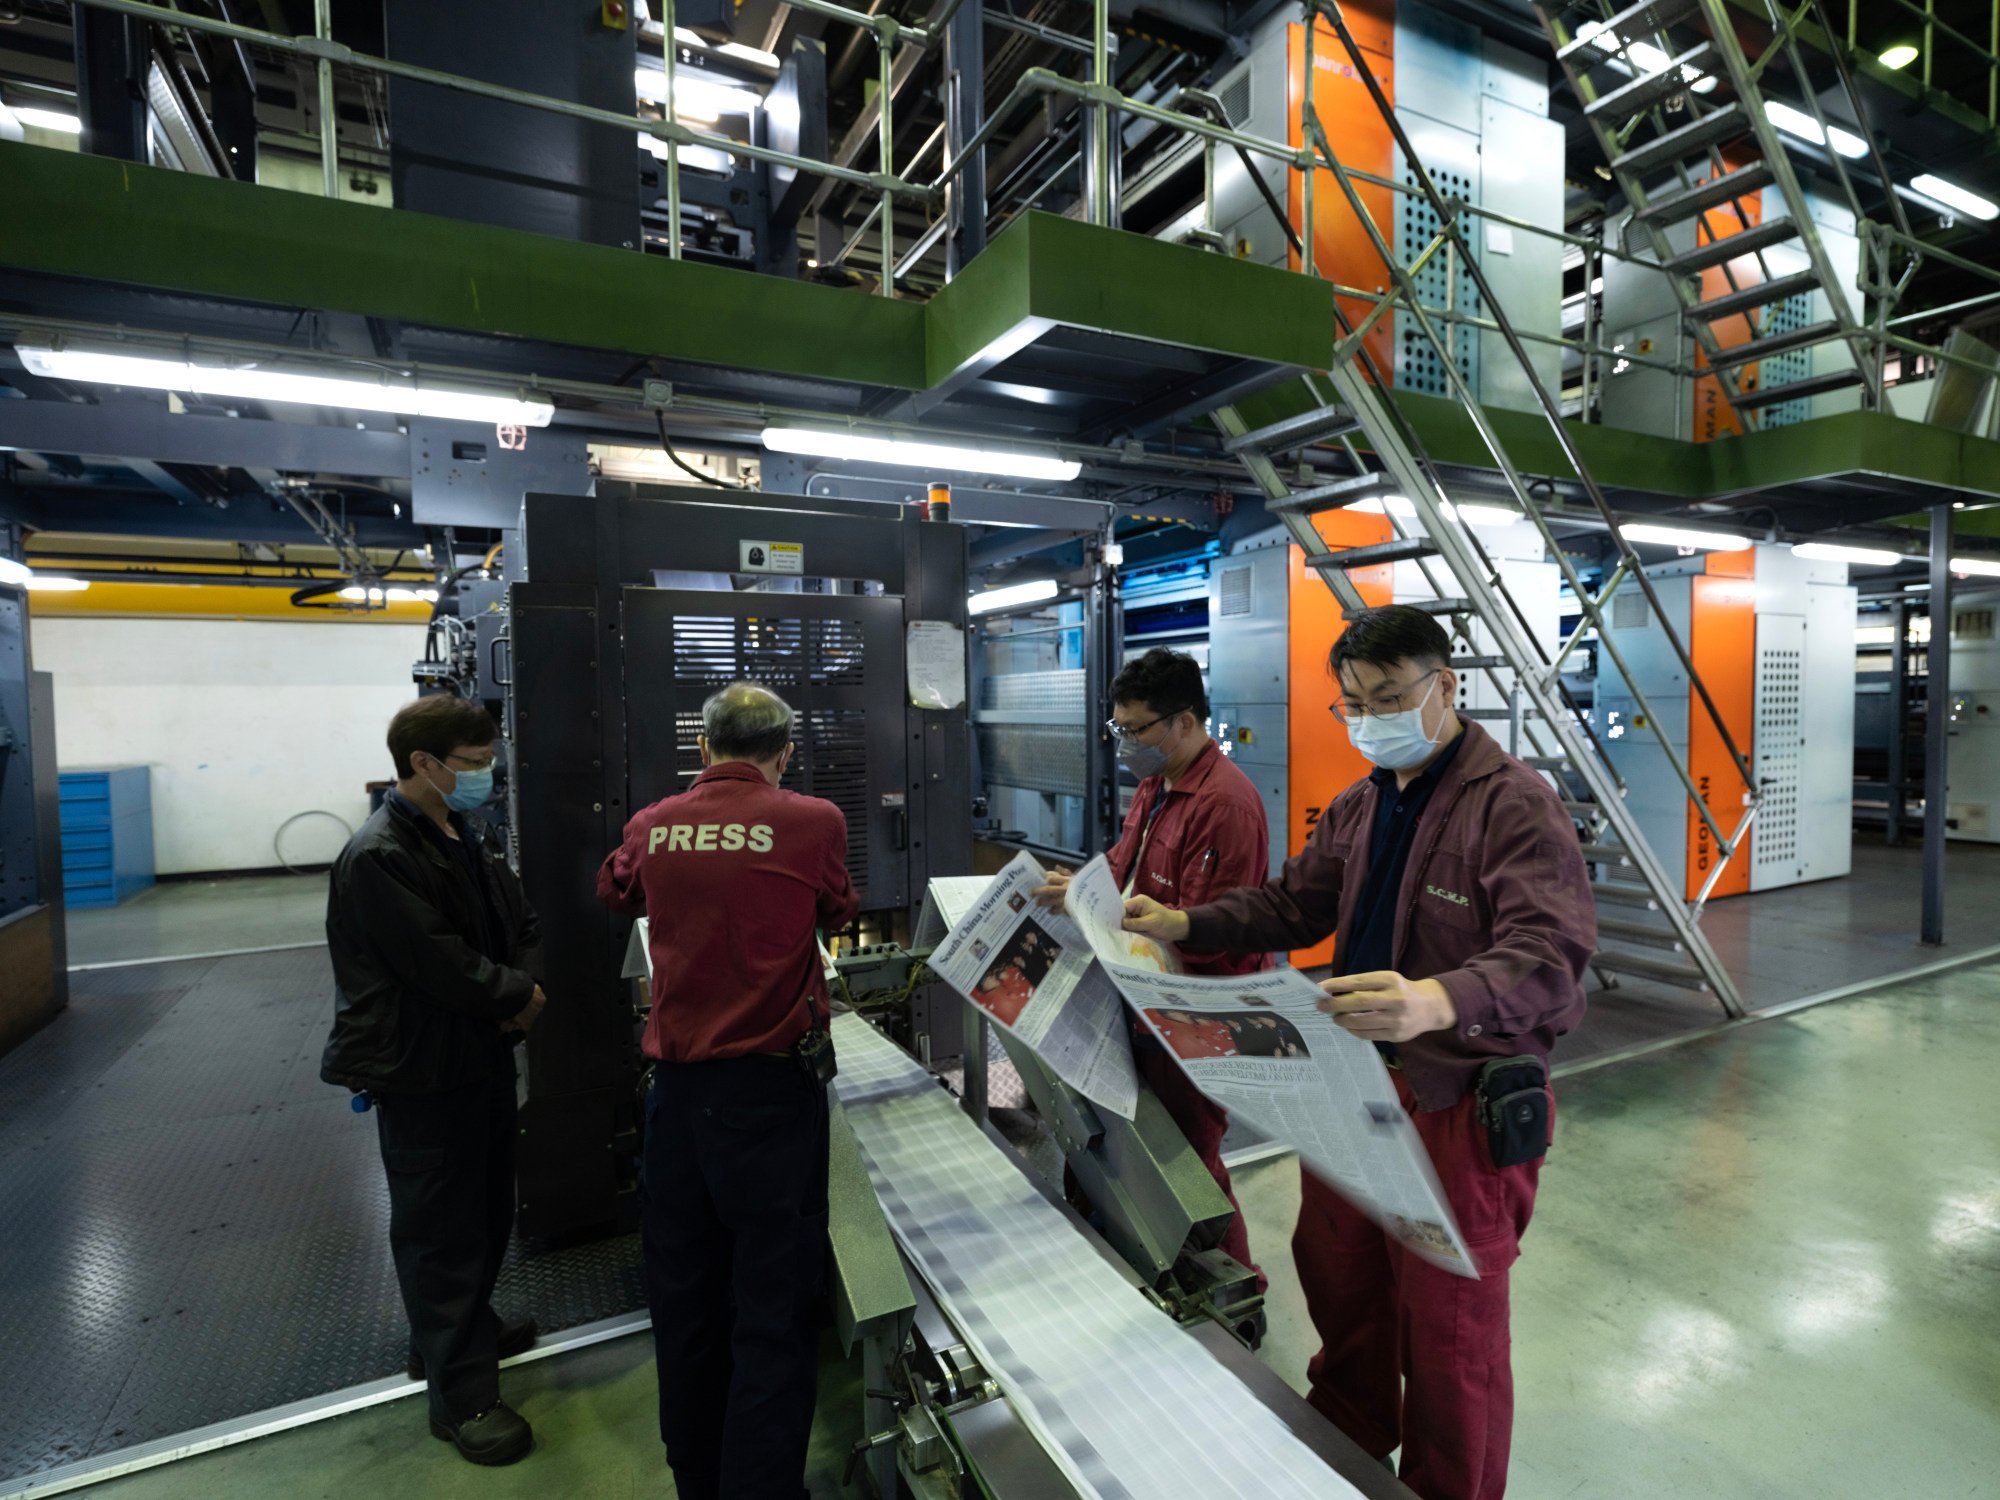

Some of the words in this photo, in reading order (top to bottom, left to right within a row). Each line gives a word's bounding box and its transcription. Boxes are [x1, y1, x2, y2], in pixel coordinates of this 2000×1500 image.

[648, 823, 774, 855] PRESS
[1426, 885, 1470, 907] S.C.M.P.
[940, 938, 963, 966] South
[958, 914, 983, 939] China
[979, 878, 1013, 913] Morning
[1007, 864, 1027, 880] Post
[1112, 969, 1147, 985] South
